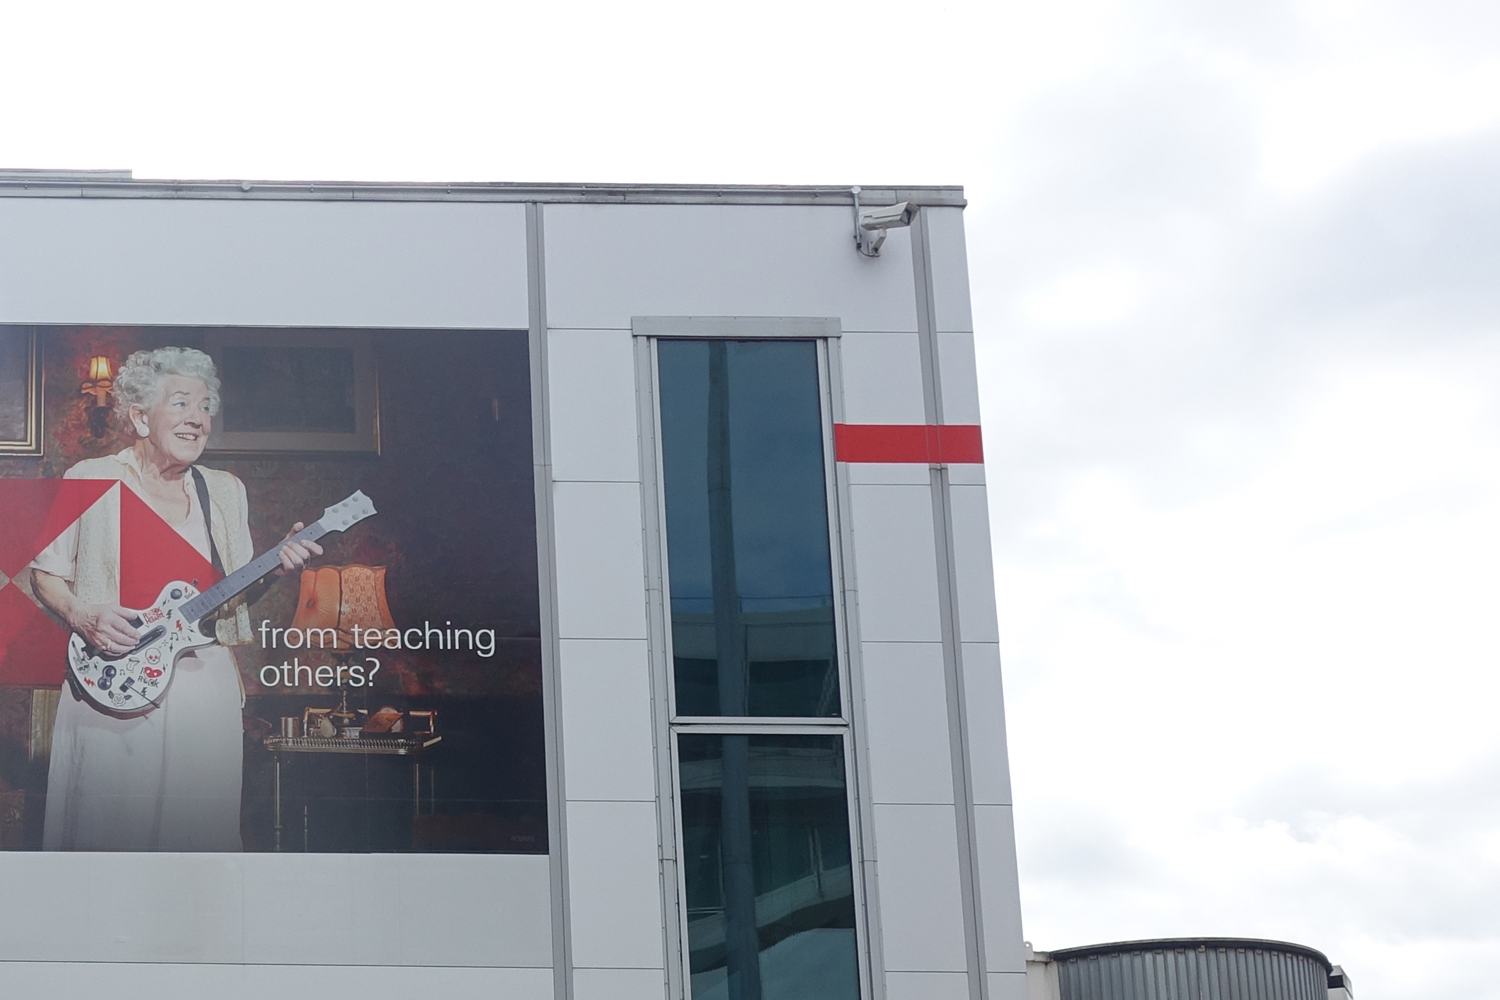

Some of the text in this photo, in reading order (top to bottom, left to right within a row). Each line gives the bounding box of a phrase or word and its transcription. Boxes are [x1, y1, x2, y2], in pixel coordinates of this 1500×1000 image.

[258, 619, 496, 658] from teaching
[259, 657, 381, 687] others?
